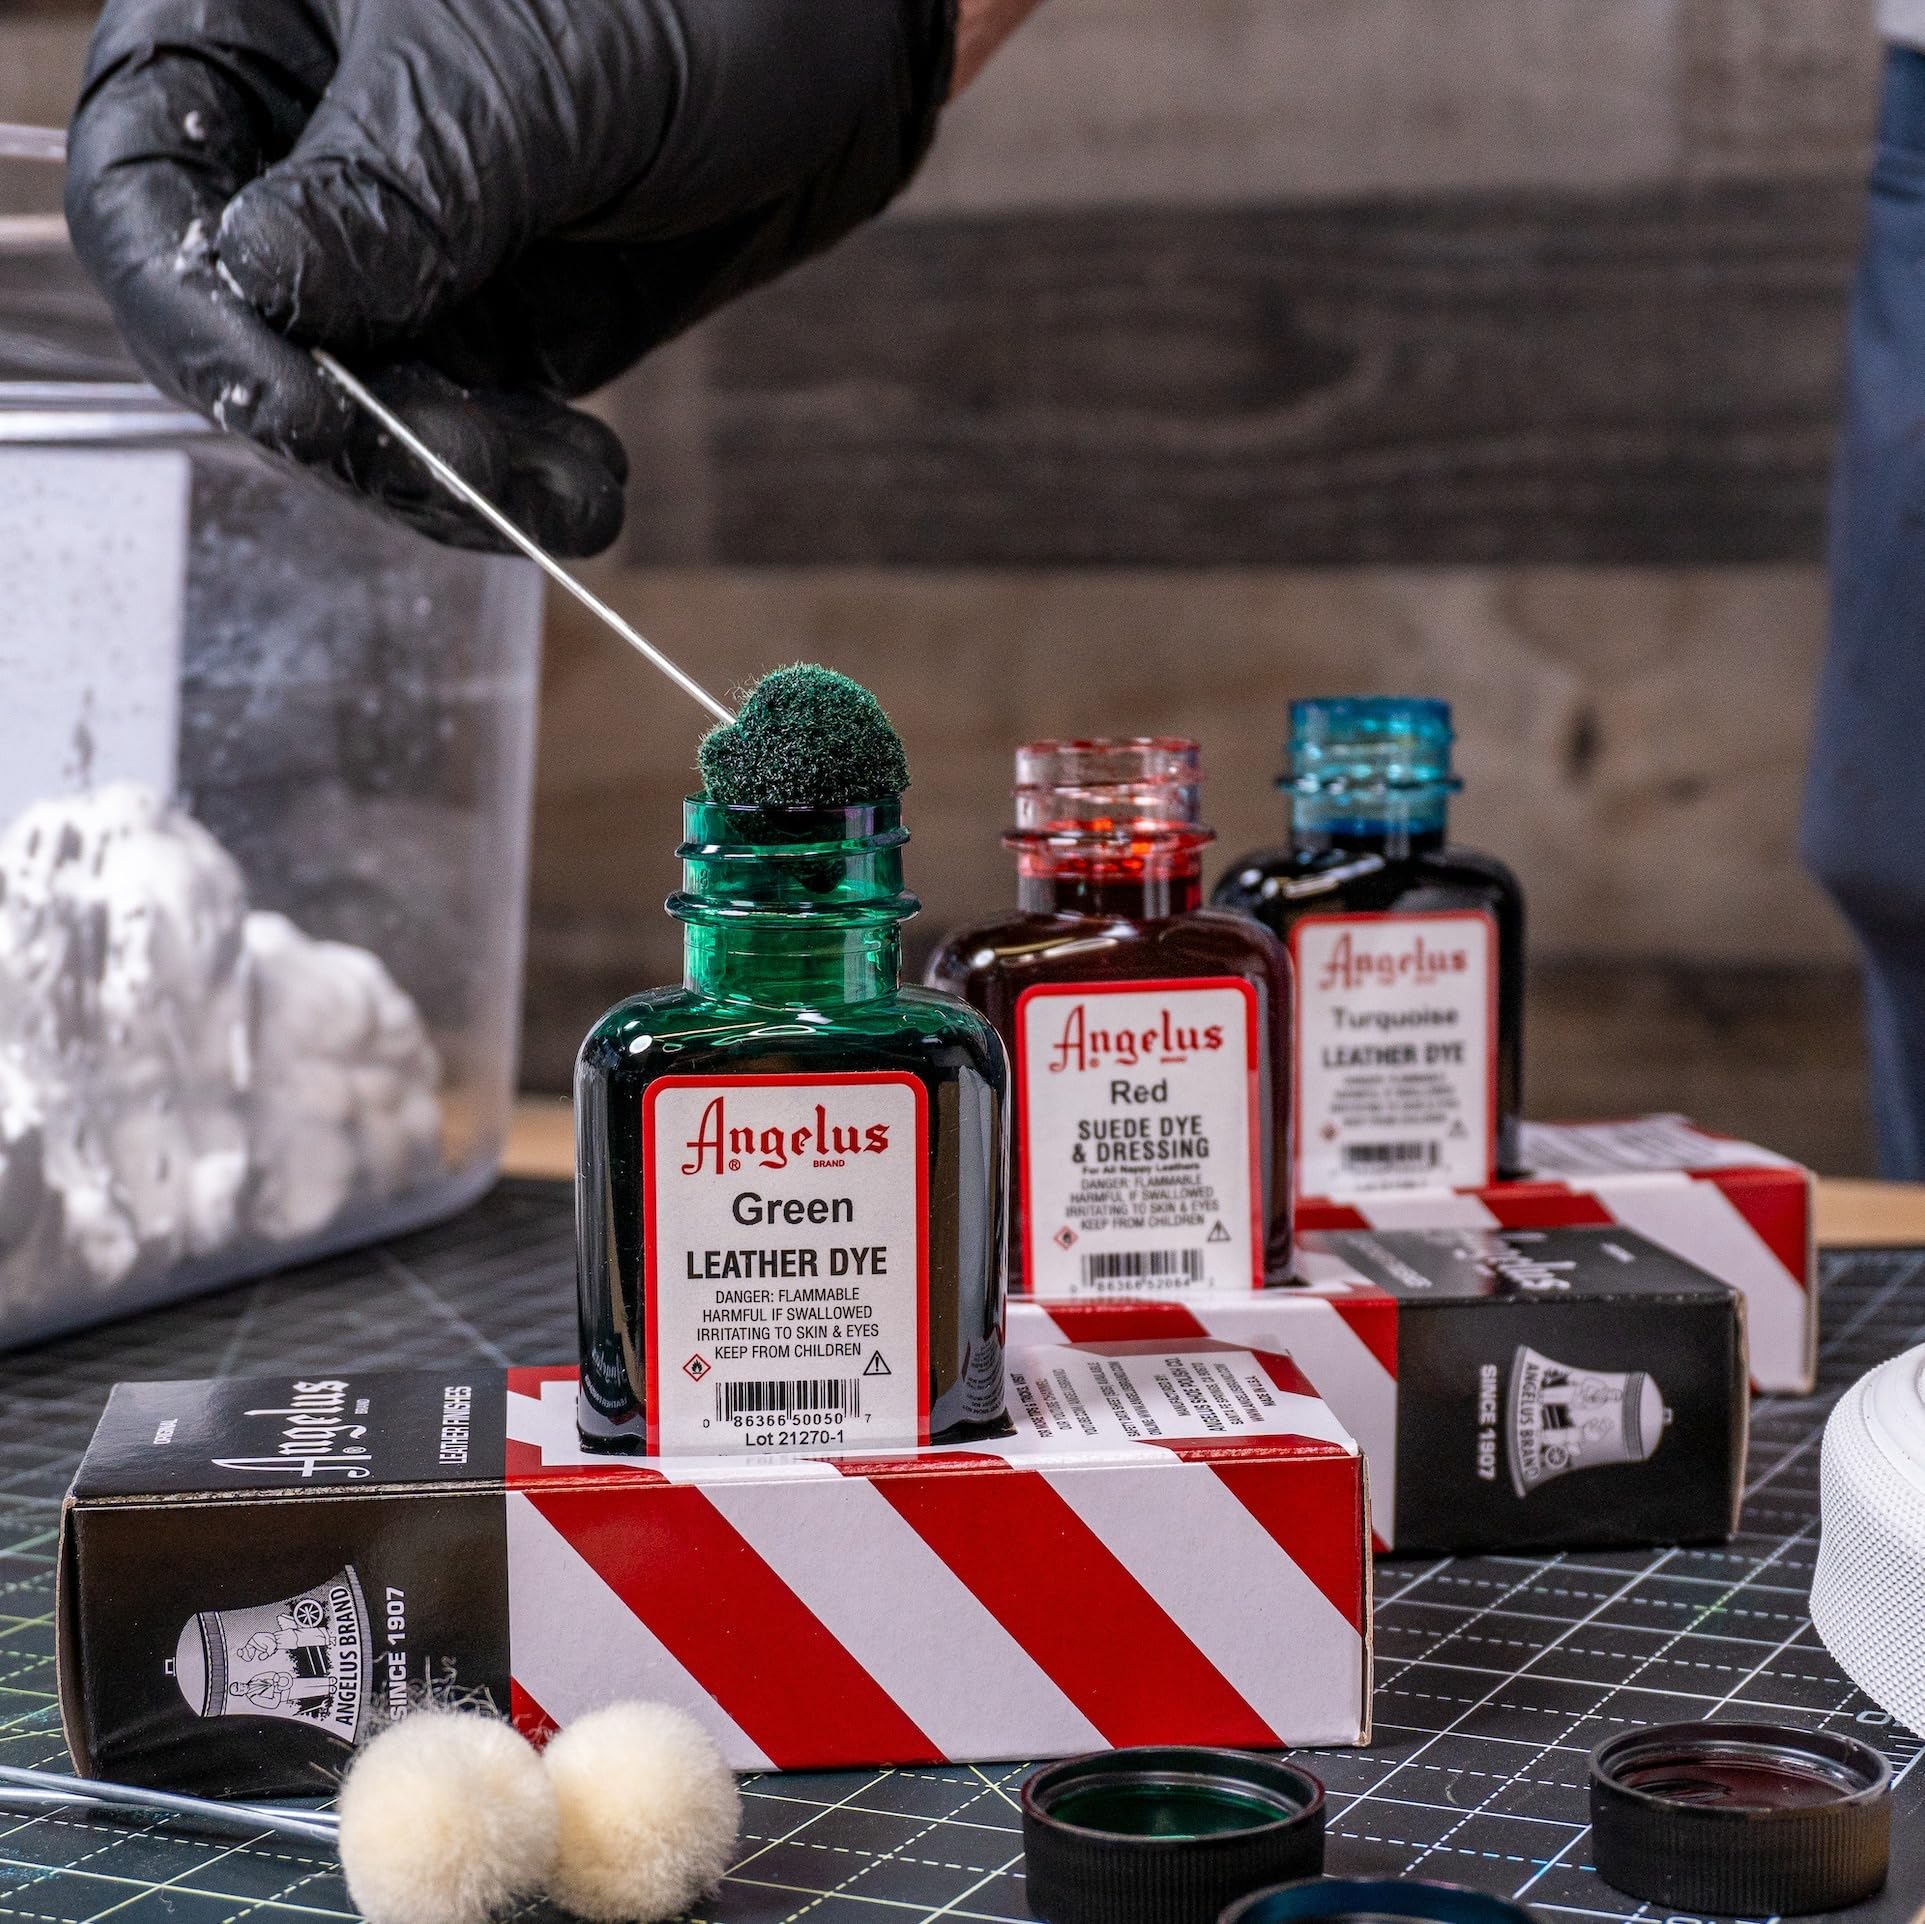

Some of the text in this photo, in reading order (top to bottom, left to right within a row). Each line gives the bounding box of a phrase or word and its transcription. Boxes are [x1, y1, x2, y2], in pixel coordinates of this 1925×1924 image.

[1332, 1006, 1458, 1030] Turquoise
[1049, 1004, 1224, 1072] Angelus
[1322, 1040, 1464, 1067] LEATHER DYE
[1111, 1078, 1168, 1104] Red
[682, 1096, 890, 1175] Angelus
[1078, 1115, 1202, 1140] SUEDE DYE
[1072, 1138, 1210, 1163] & DRESSING
[813, 1160, 845, 1168] BRAND
[1135, 1174, 1201, 1186] FLAMMABLE
[1070, 1187, 1214, 1203] HARMFUL IF SWALLOWED
[732, 1192, 853, 1225] Green
[1066, 1204, 1128, 1217] IRRITATING
[1133, 1203, 1146, 1215] TO
[1151, 1202, 1175, 1213] SKIN
[1192, 1199, 1219, 1211] EYES
[1081, 1214, 1205, 1231] KEEP FROM CHILDREN
[687, 1246, 888, 1280] LEATHER DYE
[715, 1287, 860, 1304] DANGER: FLAMMABLE
[702, 1305, 873, 1323] HARMFUL IF SWALLOWED
[696, 1324, 879, 1342] IRRITATING TO SKIN & EYES
[715, 1342, 862, 1360] KEEP FROM CHILDREN
[354, 1398, 370, 1415] BRAND
[153, 1418, 178, 1446] ORIGINAL
[211, 1380, 372, 1478] Angelus
[439, 1386, 472, 1464] LEATHER FINISHES
[702, 1412, 872, 1428] 0 86366 50050 7
[1477, 1363, 1497, 1481] SINCE 1907
[1520, 1362, 1541, 1479] ANGELUS BRAND
[745, 1429, 843, 1446] Lot 21270-1
[330, 1586, 358, 1726] ANGELUS BRAND
[386, 1586, 409, 1720] SINCE 1907
